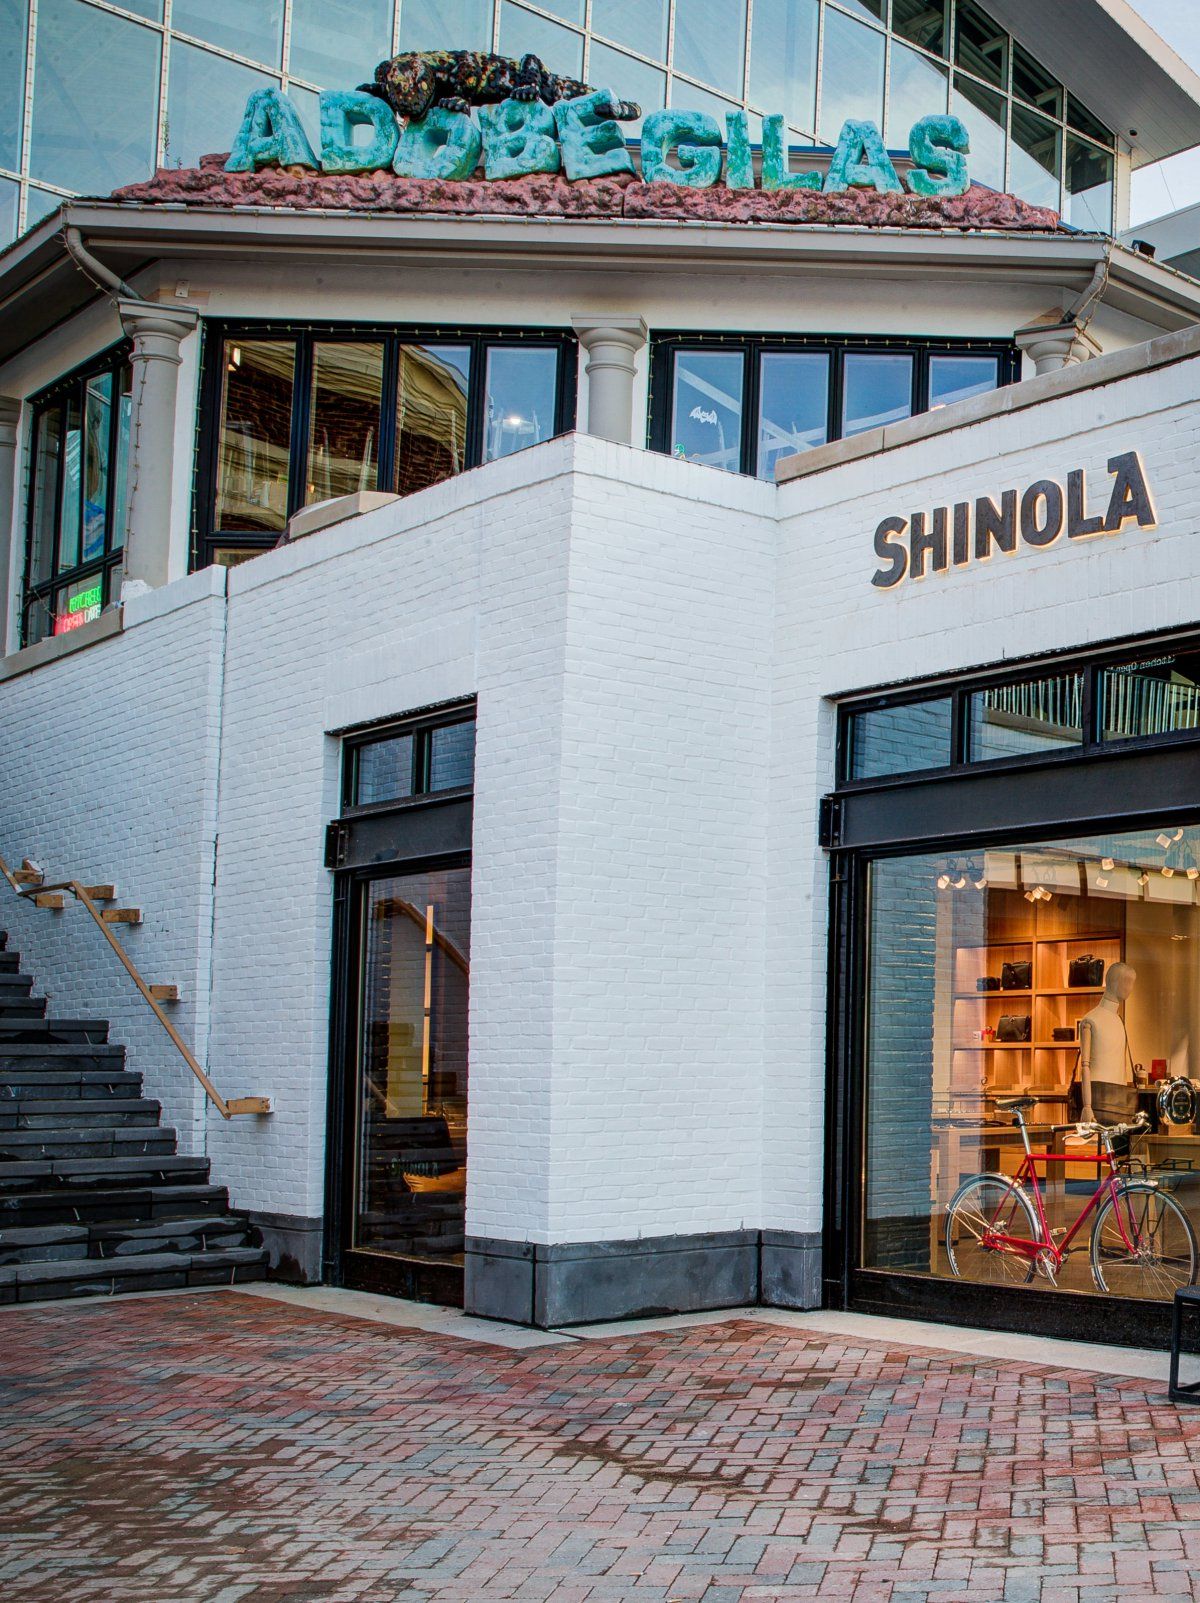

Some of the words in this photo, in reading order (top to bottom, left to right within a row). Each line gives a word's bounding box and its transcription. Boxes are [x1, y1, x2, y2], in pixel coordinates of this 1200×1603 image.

[224, 88, 635, 182] ADOBE
[642, 108, 971, 197] GILAS
[871, 450, 1157, 589] SHINOLA
